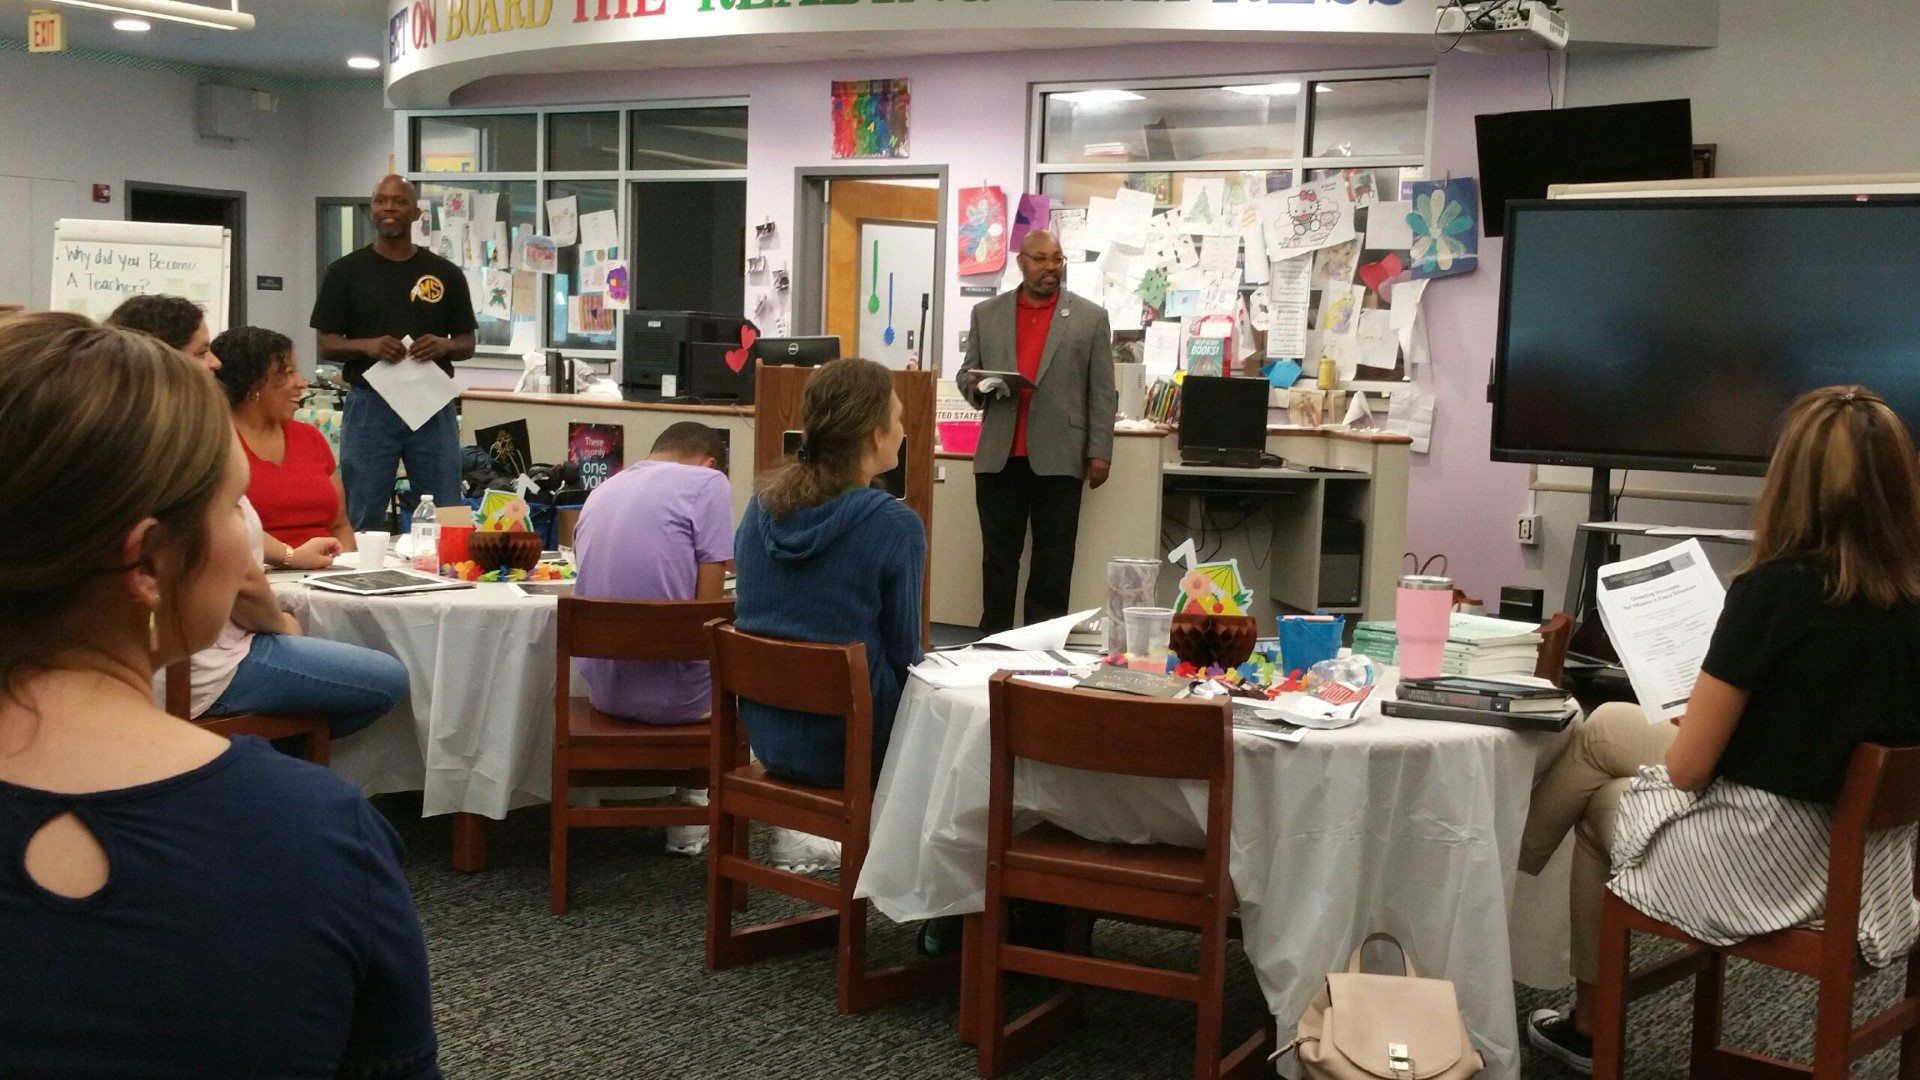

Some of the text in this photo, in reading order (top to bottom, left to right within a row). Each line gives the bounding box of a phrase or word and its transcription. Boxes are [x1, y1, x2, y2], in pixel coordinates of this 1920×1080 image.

[34, 20, 55, 47] EXIT
[412, 1, 437, 49] ON
[445, 0, 552, 41] BOARD
[66, 245, 91, 270] Why
[95, 248, 113, 265] did
[118, 254, 140, 271] you
[66, 272, 150, 294] A Teacher?
[420, 279, 441, 299] MS
[1191, 345, 1220, 356] BOOKS!
[583, 462, 607, 474] one
